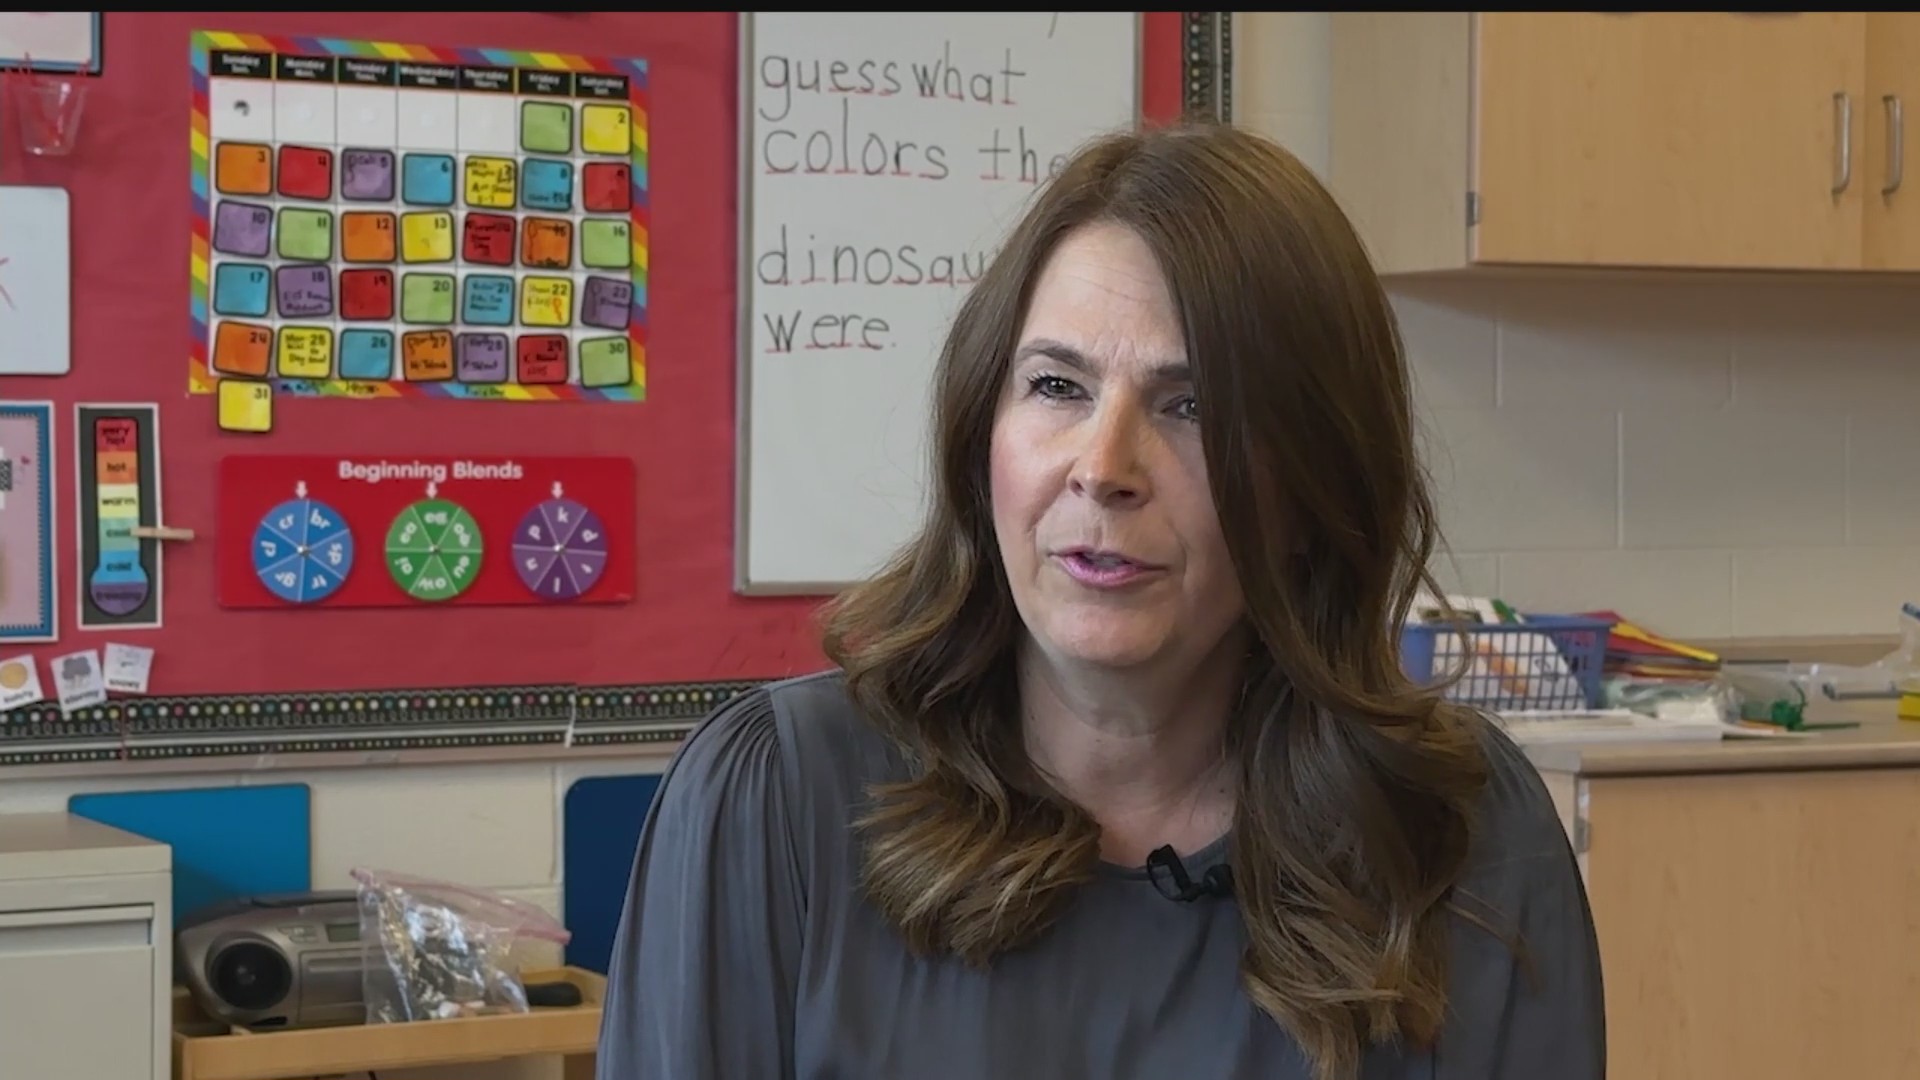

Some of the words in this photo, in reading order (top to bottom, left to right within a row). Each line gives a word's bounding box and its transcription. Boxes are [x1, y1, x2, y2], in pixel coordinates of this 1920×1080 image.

[222, 54, 260, 67] Sunday
[285, 58, 326, 72] Monday
[346, 61, 387, 74] Tuesday
[401, 66, 456, 79] Wednesday
[465, 69, 509, 82] Thursday
[529, 73, 560, 86] Friday
[758, 54, 902, 122] guess
[911, 40, 1027, 105] what
[580, 76, 624, 89] Saturday
[763, 97, 950, 180] colors
[252, 211, 265, 224] 10
[317, 216, 326, 228] 11
[376, 217, 389, 230] 12
[434, 217, 447, 230] 13
[613, 225, 625, 237] 16
[757, 223, 1000, 287] dinosau
[250, 271, 264, 283] 17
[312, 271, 325, 283] 18
[374, 275, 387, 286] 19
[433, 280, 450, 292] 20
[497, 282, 510, 294] 21
[552, 284, 568, 296] 22
[613, 286, 628, 298] 23
[250, 332, 267, 344] 24
[310, 334, 326, 346] 25
[371, 336, 387, 348] 26
[432, 337, 447, 348] 27
[487, 340, 503, 352] 28
[546, 340, 562, 352] 29
[608, 342, 625, 354] 30
[254, 387, 268, 400] 31
[106, 462, 127, 472] hot
[339, 460, 447, 483] Beginning
[453, 460, 523, 479] Blends
[102, 498, 136, 506] warm
[310, 507, 331, 529] br
[557, 506, 569, 523] k
[279, 514, 294, 529] cr
[328, 543, 343, 566] sp
[275, 572, 297, 588] gr
